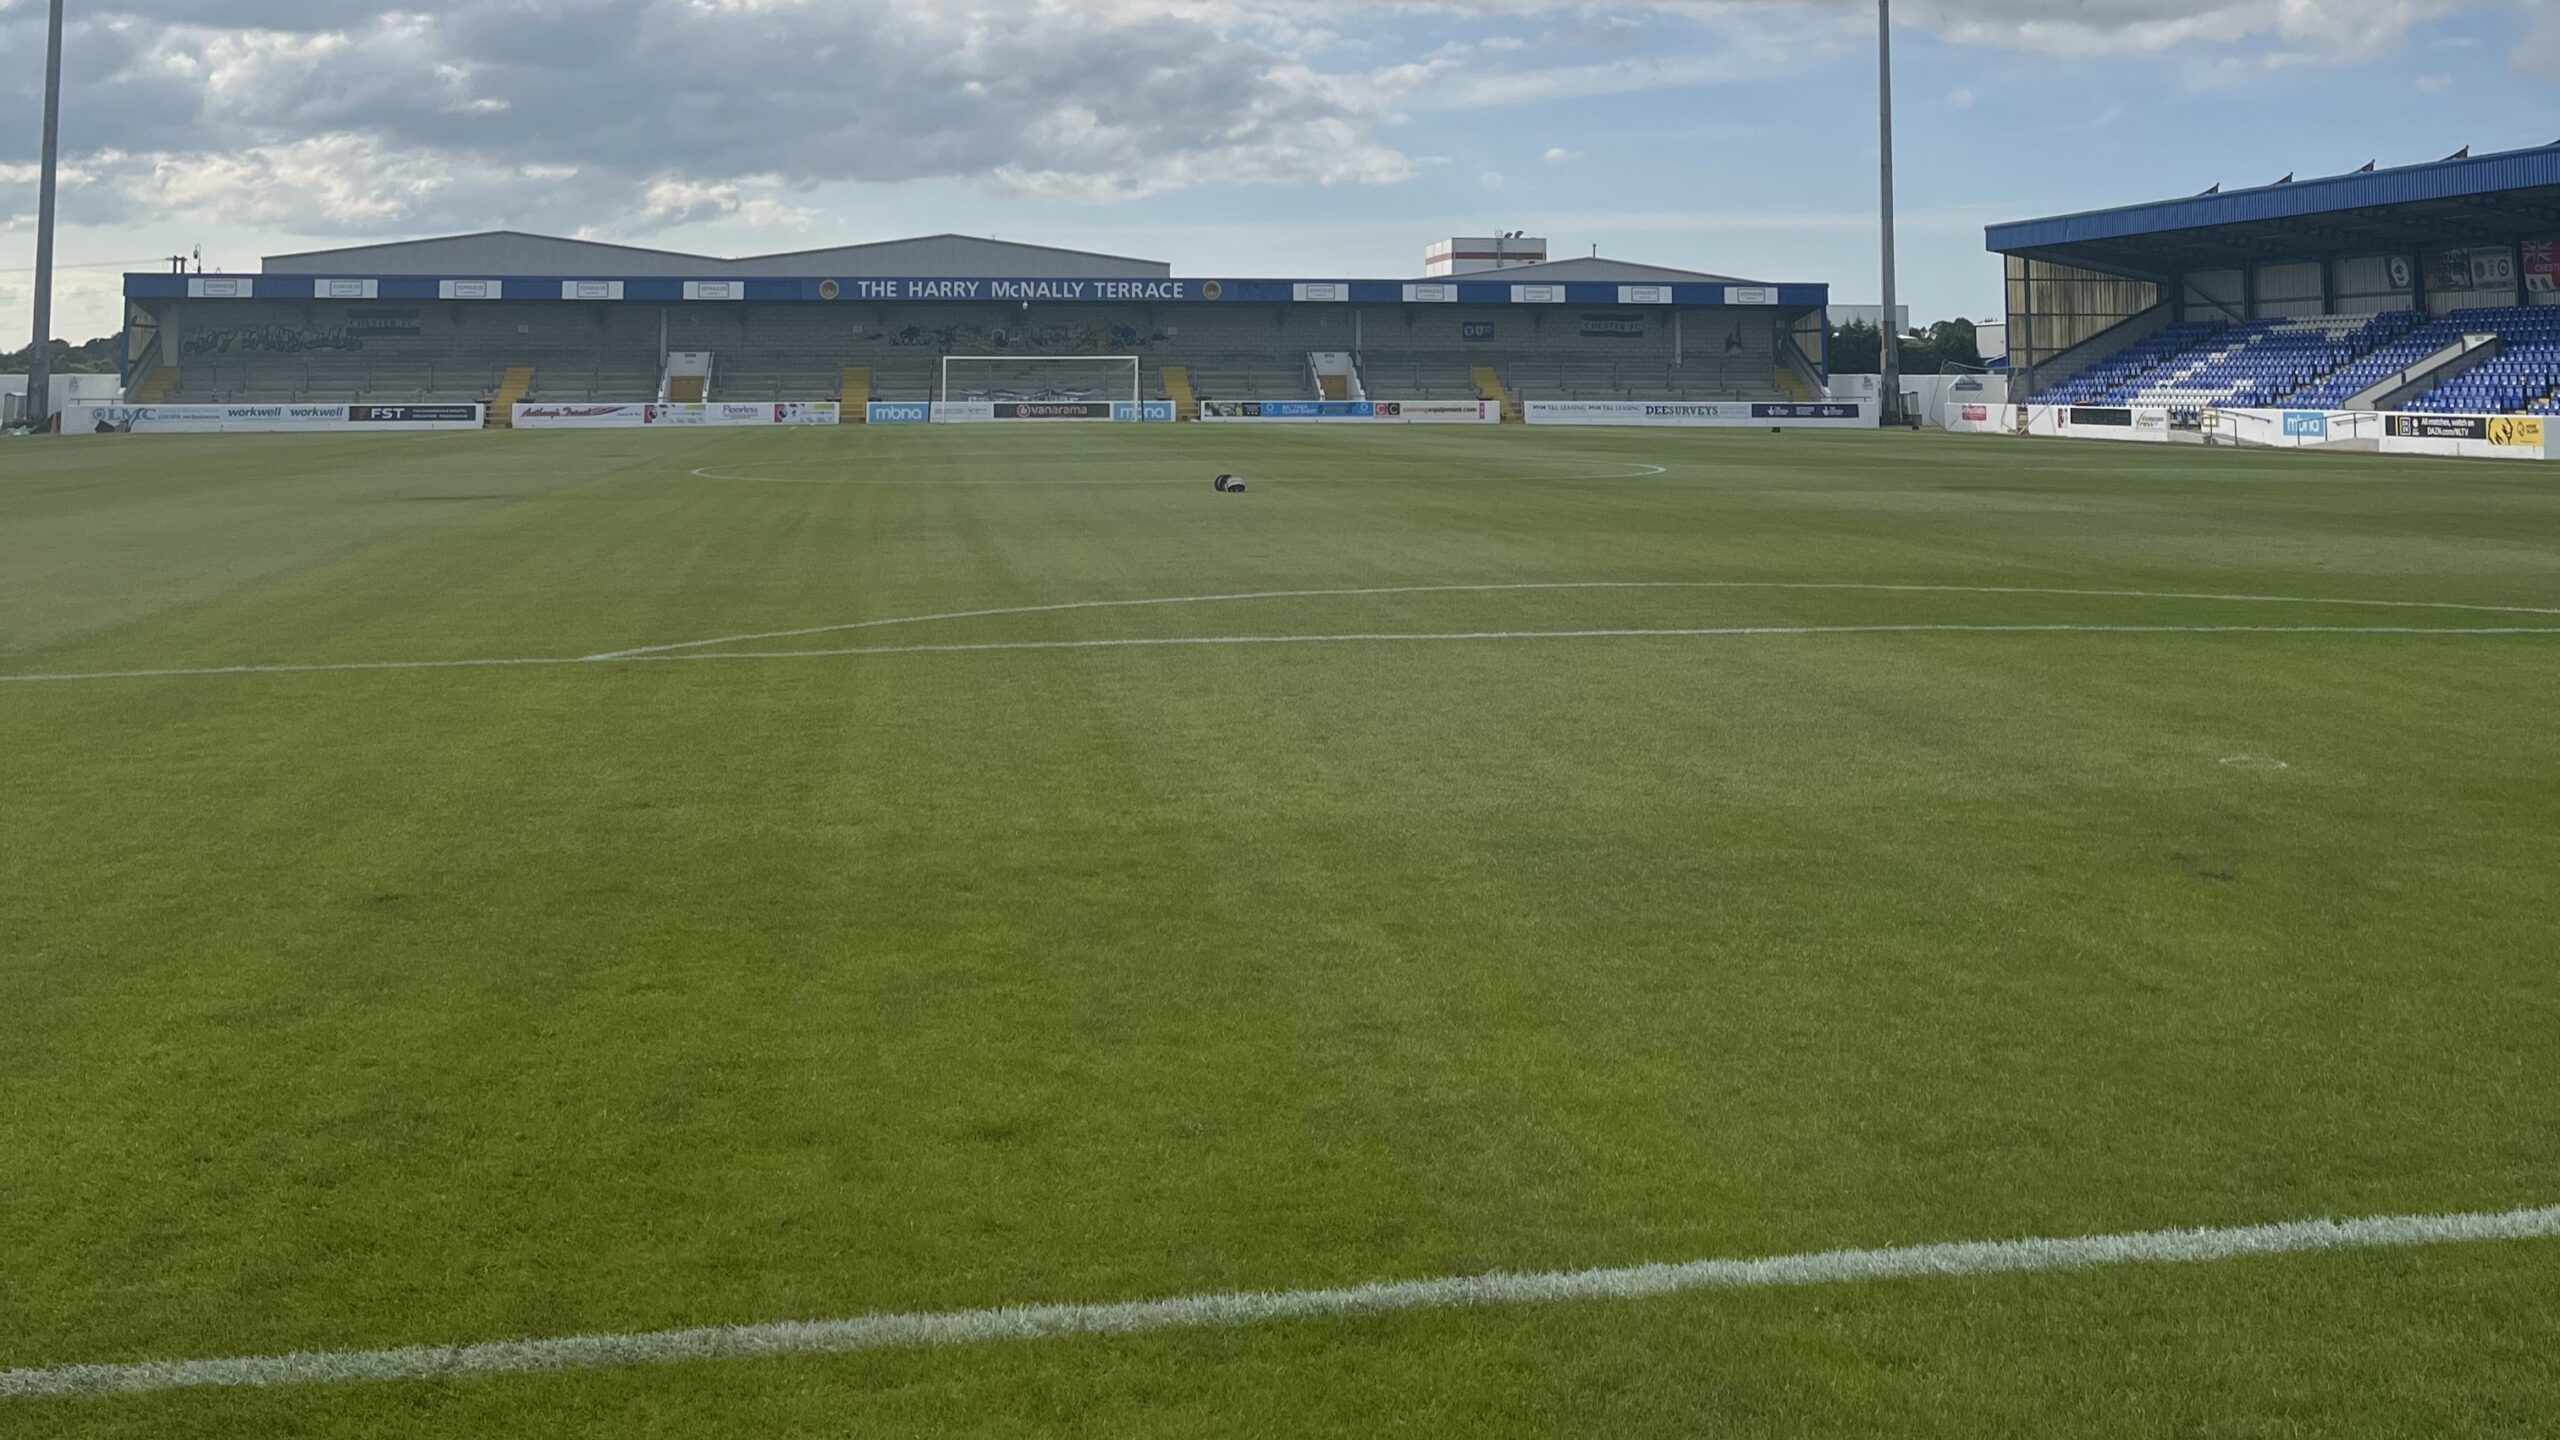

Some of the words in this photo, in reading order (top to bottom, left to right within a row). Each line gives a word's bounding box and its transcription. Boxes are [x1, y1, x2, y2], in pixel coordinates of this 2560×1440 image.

[858, 281, 897, 297] THE
[908, 281, 980, 297] HARRY
[991, 281, 1084, 298] McNALLY
[1094, 282, 1183, 298] TERRACE
[108, 408, 157, 420] LMC
[228, 407, 282, 417] workwell
[290, 407, 344, 417] workwell
[371, 408, 405, 419] FST
[875, 406, 922, 420] mbna
[1030, 405, 1088, 415] vanarama
[1646, 406, 1719, 416] DEESURVEYS
[2287, 413, 2320, 433] mbna
